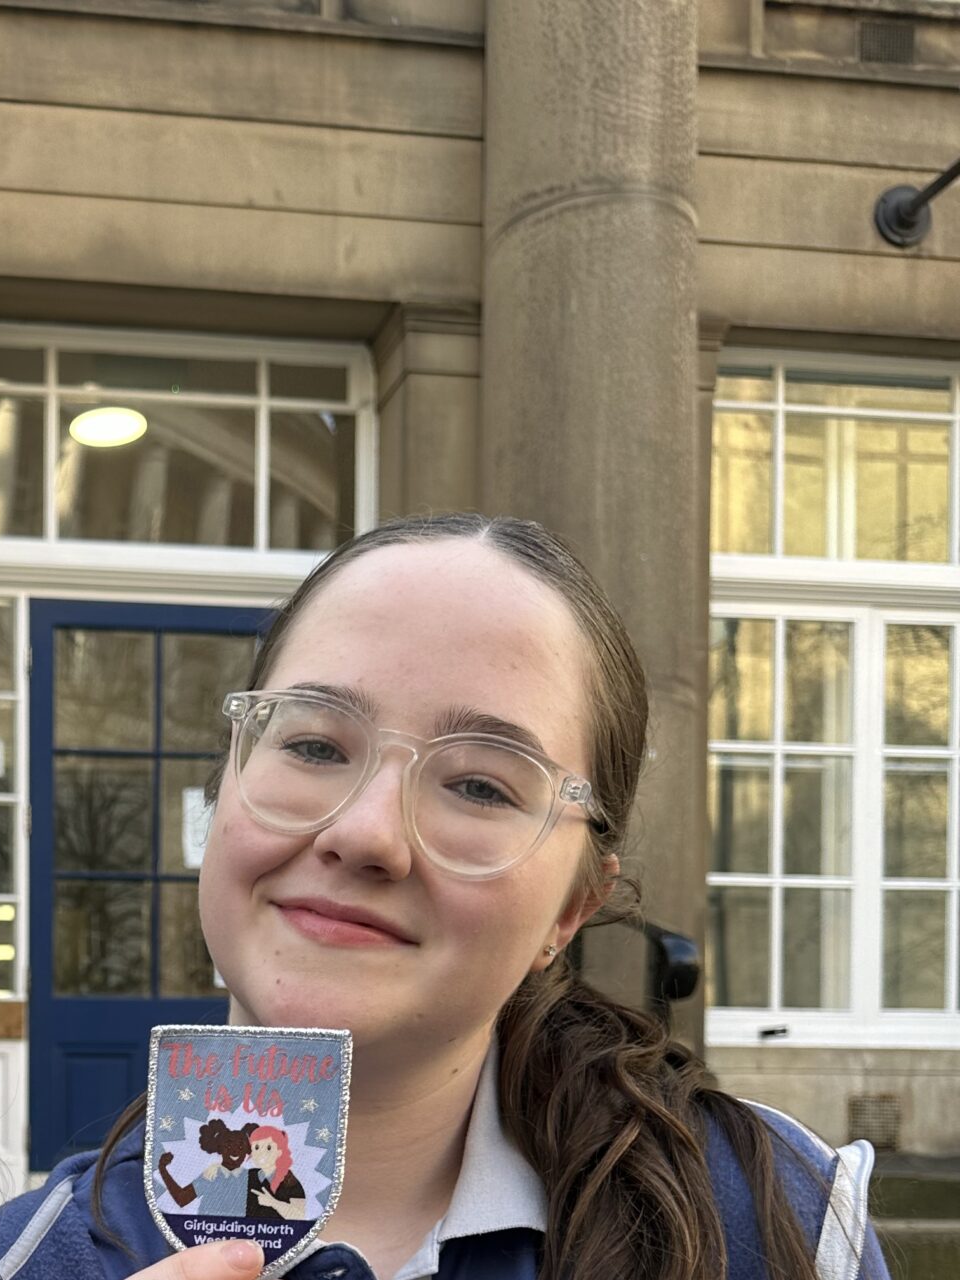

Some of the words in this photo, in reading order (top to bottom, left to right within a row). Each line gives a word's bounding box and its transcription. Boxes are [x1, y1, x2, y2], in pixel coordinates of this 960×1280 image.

[161, 1042, 224, 1080] The
[229, 1044, 339, 1084] Future
[204, 1080, 235, 1113] is
[243, 1081, 287, 1117] Us
[184, 1219, 255, 1236] Girlguiding
[258, 1224, 294, 1235] North
